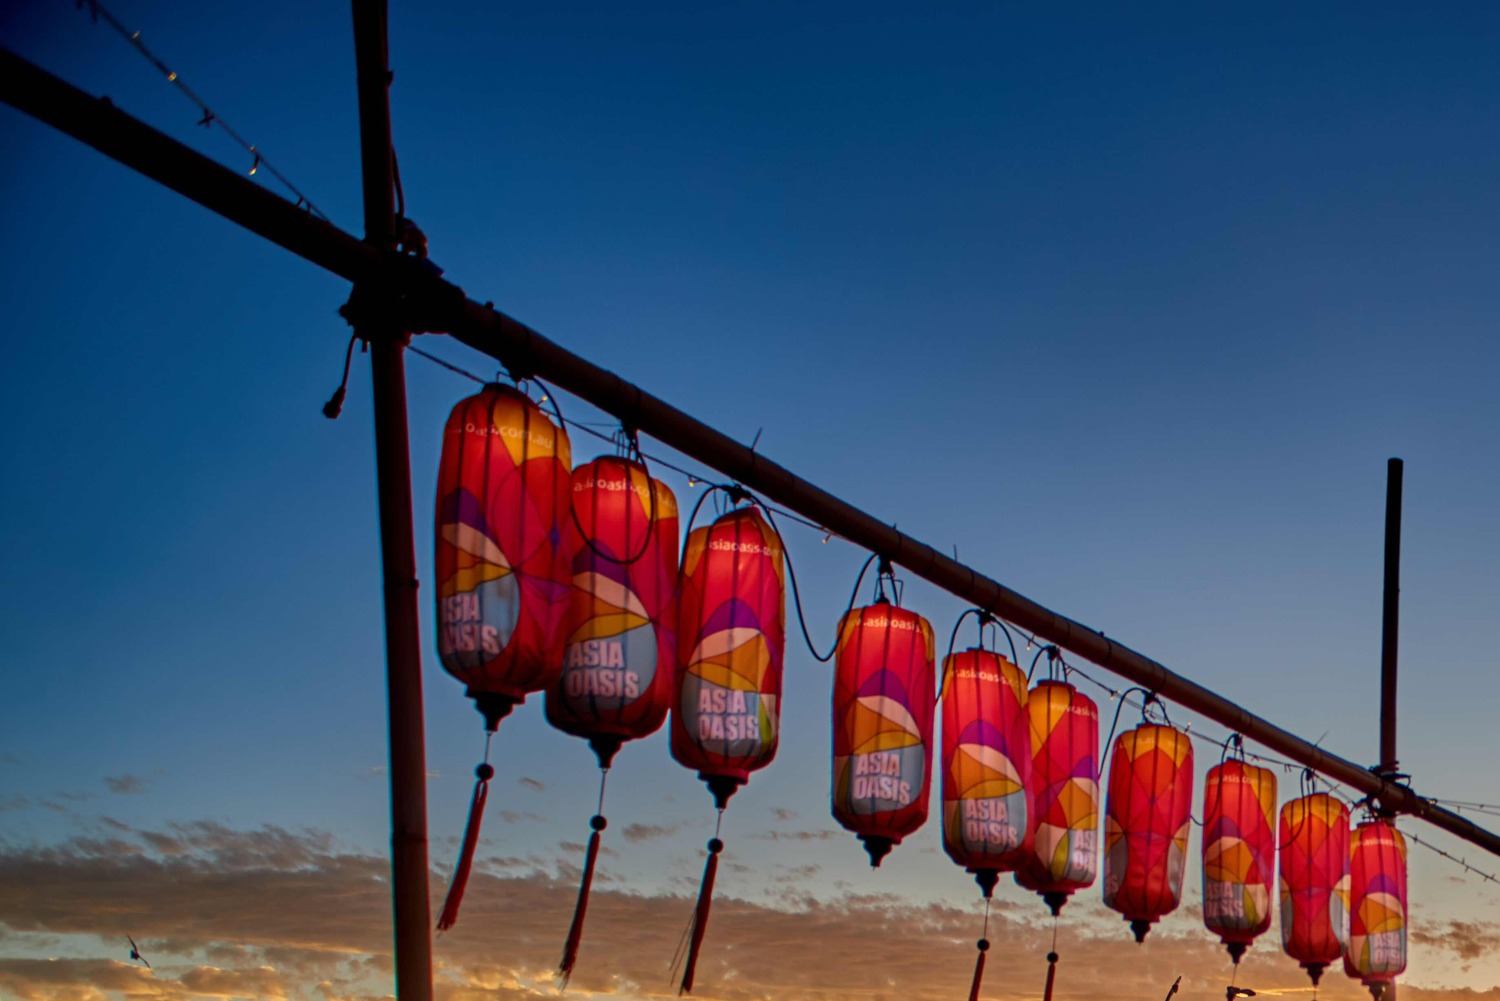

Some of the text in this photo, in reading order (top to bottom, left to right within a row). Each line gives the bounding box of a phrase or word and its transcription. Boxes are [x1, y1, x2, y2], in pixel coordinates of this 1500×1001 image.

[568, 640, 624, 669] ASIA
[567, 668, 640, 700] OASIS
[698, 689, 747, 714] ASIA
[699, 712, 759, 742] OASIS
[855, 752, 900, 778] ASIA
[853, 775, 911, 805] OASIS
[965, 798, 1009, 822] ASIA
[965, 818, 1018, 849] OASIS
